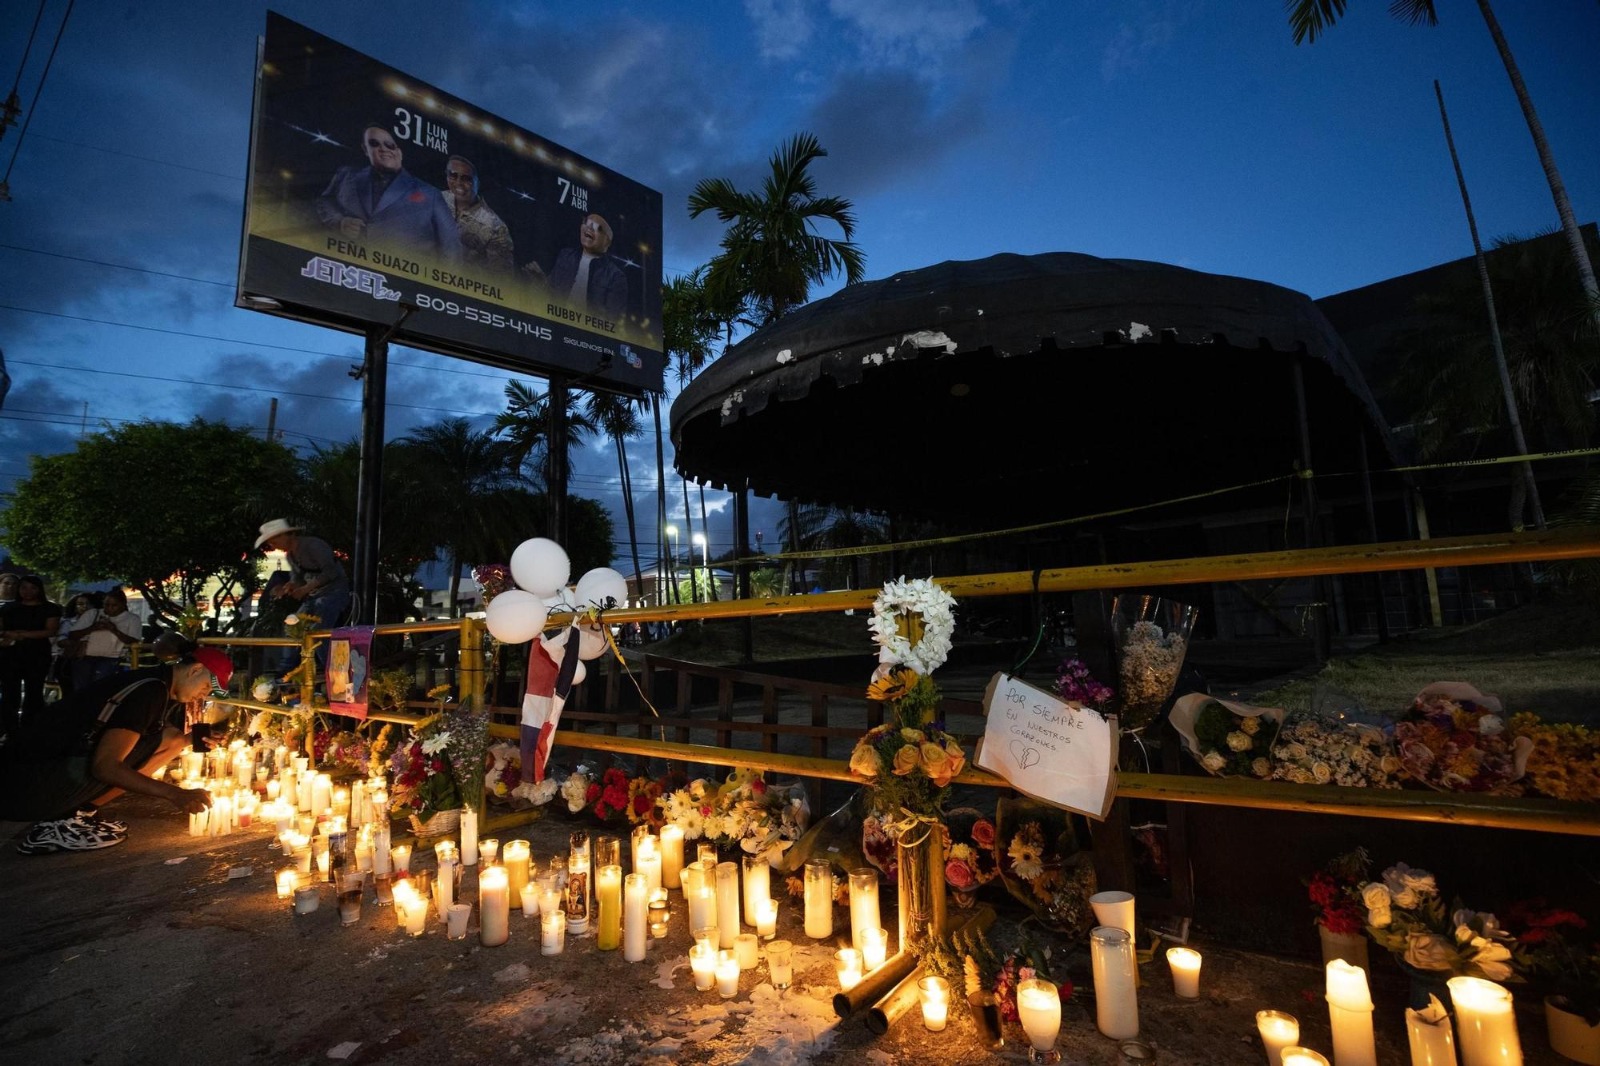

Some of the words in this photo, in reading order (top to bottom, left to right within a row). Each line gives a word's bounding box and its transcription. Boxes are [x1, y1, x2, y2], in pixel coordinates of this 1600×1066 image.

[394, 107, 424, 147] 31
[427, 121, 448, 141] LUN
[426, 134, 448, 154] MAR
[557, 176, 570, 204] 7
[572, 184, 588, 201] LUN
[571, 196, 588, 212] ABR
[327, 237, 367, 261] PEÑA
[372, 250, 419, 275] SUAZO
[432, 268, 504, 301] SEXAPPEAL
[416, 293, 553, 341] 809-535-4145
[547, 303, 582, 323] RUBBY
[585, 315, 616, 334] PEREZ
[563, 336, 602, 353] SIGUENOS
[1005, 687, 1027, 709] POR
[1006, 709, 1019, 721] EN
[1027, 721, 1072, 744] NUESTROS
